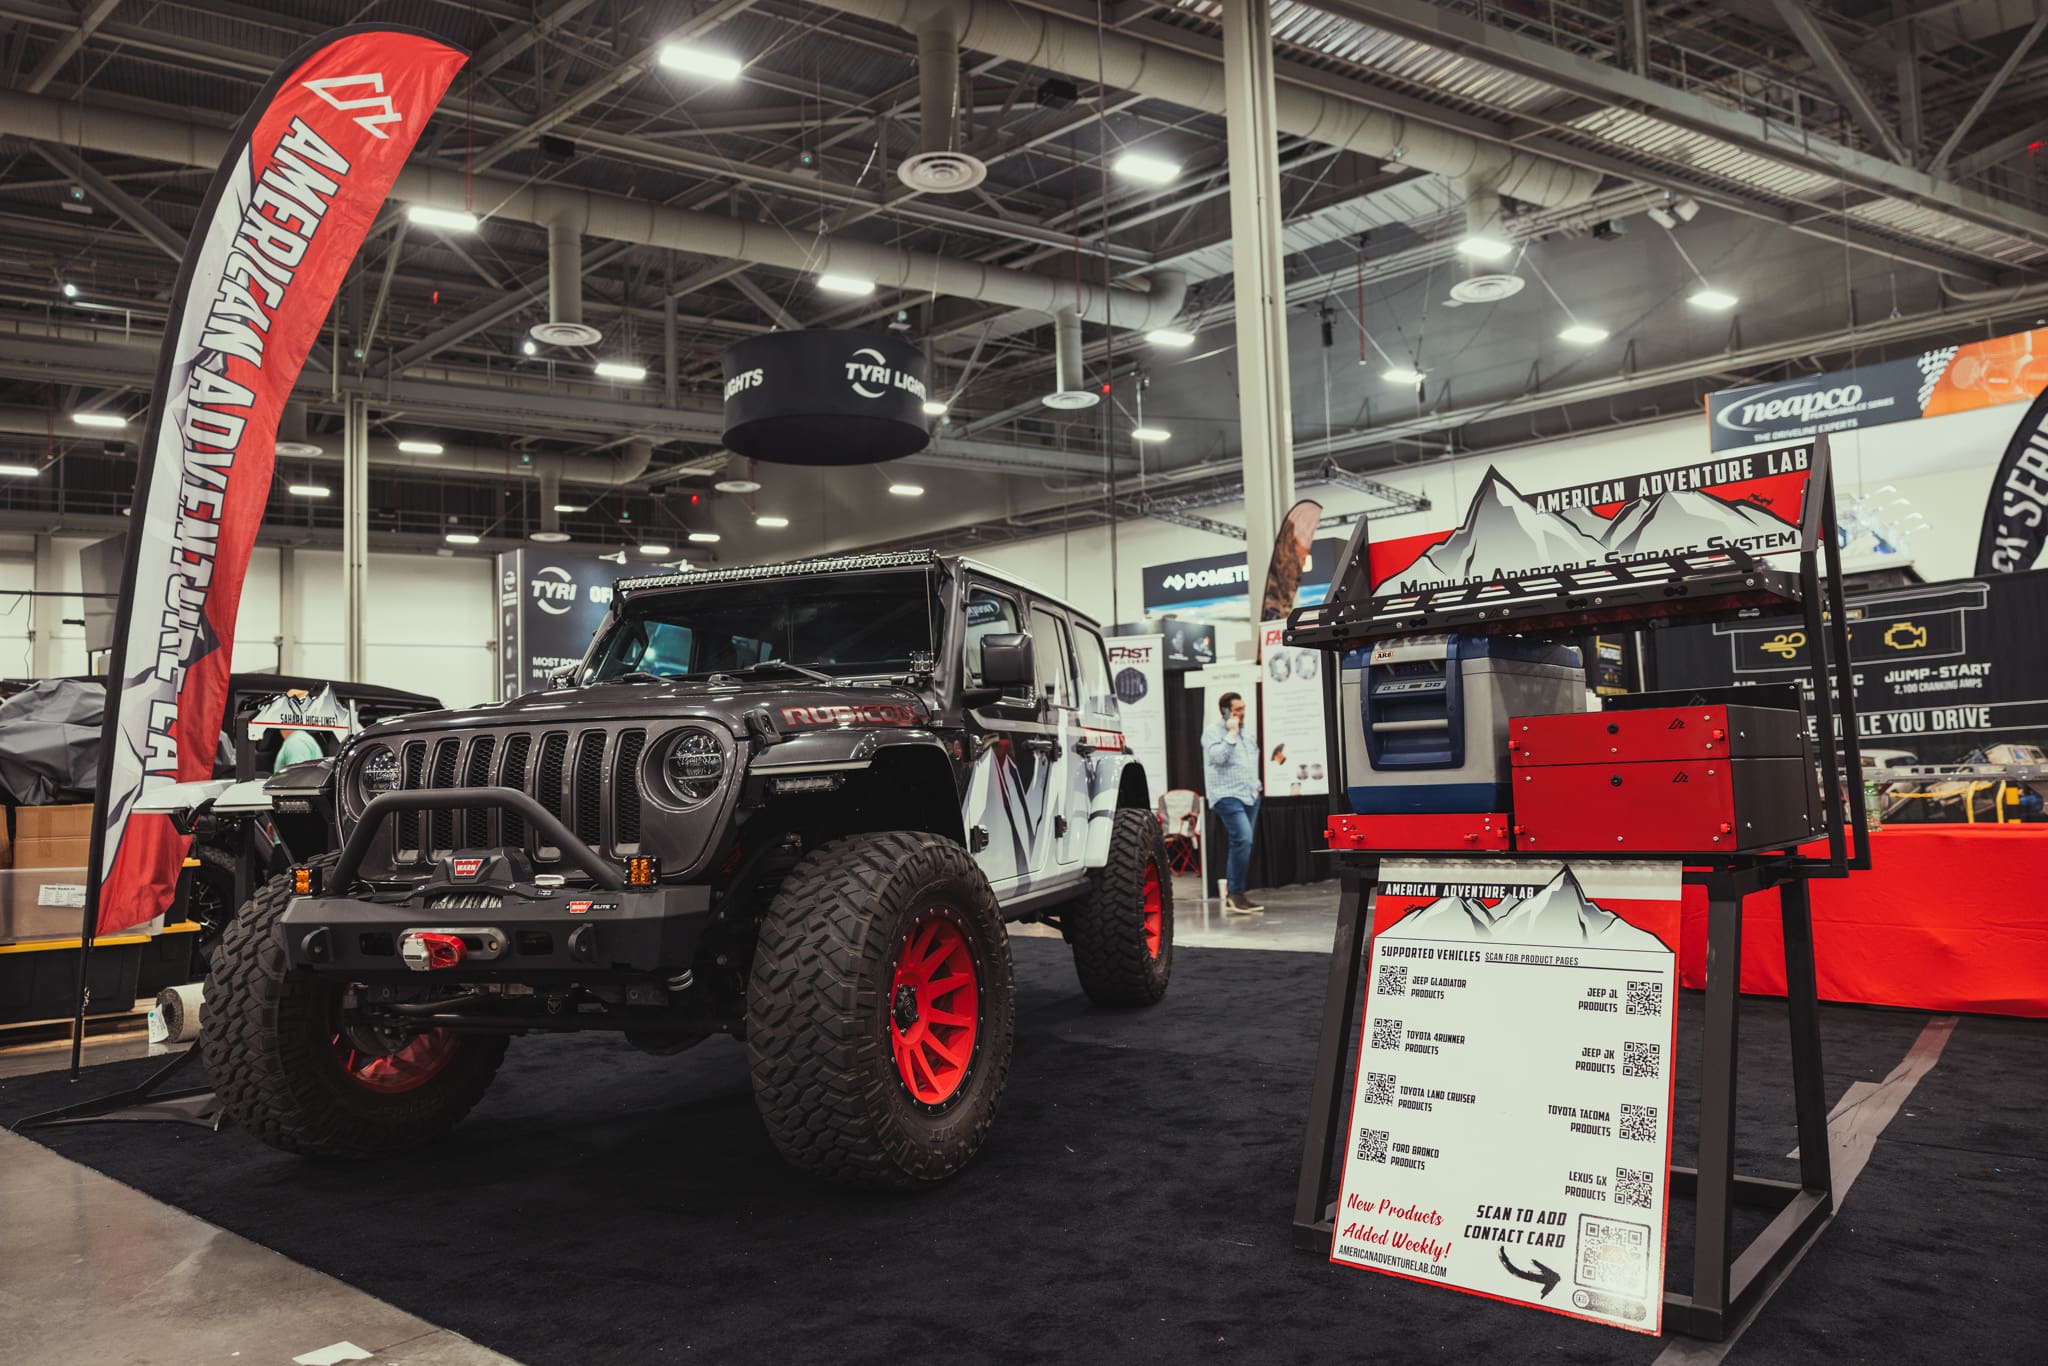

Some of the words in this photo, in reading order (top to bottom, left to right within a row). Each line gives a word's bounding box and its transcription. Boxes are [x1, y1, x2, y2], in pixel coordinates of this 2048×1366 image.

[200, 116, 351, 369] AMERICAN
[846, 362, 891, 384] TYRI
[1742, 385, 1862, 425] neapco
[1754, 433, 1771, 442] THE
[1818, 420, 1858, 433] EXPERTS
[1536, 482, 1624, 515] AMERICAN
[1638, 459, 1752, 498] ADVENTURE
[1768, 449, 1808, 475] LAB
[532, 580, 577, 600] TYRI
[532, 656, 559, 666] MOST
[1108, 647, 1152, 662] FAST
[532, 669, 544, 678] IN
[1884, 663, 1991, 683] JUMP-START
[1960, 678, 1982, 688] AMPS
[280, 714, 303, 725] SAHARA
[1887, 712, 1925, 733] YOU
[1932, 708, 1991, 730] DRIVE
[1386, 884, 1436, 896] AMERICAN
[1443, 885, 1505, 898] ADVENTURE
[1512, 887, 1534, 899] LAB
[1381, 946, 1434, 959] SUPPORTED
[1437, 949, 1480, 962] VEHICLES
[1485, 952, 1503, 962] SCAN
[1505, 953, 1519, 962] FOR
[1521, 954, 1553, 964] PRODUCT
[1555, 956, 1579, 966] PAGES
[1412, 976, 1428, 985] JEEP
[1431, 977, 1467, 988] GLADIATOR
[1411, 988, 1444, 1000] PRODUCTS
[1587, 988, 1606, 998] JEEP
[1609, 990, 1618, 998] JL
[1578, 1001, 1618, 1012] PRODUCTS
[1406, 1030, 1431, 1041] TOYOTA
[1434, 1033, 1465, 1044] 4RUNNER
[1405, 1043, 1439, 1055] PRODUCTS
[1582, 1047, 1601, 1057] JEEP
[1604, 1050, 1614, 1059] JK
[1576, 1061, 1615, 1074] PRODUCTS
[1400, 1086, 1425, 1097] TOYOTA
[1427, 1089, 1445, 1100] LAND
[1447, 1092, 1476, 1104] CRUISER
[1398, 1099, 1432, 1112] PRODUCTS
[1548, 1104, 1576, 1117] TOYOTA
[1580, 1109, 1610, 1121] TACOMA
[1571, 1122, 1611, 1136] PRODUCTS
[1392, 1142, 1410, 1154] FORD
[1412, 1146, 1439, 1158] BRONCO
[1390, 1156, 1425, 1170] PRODUCTS
[1569, 1170, 1593, 1184] LEXUS
[1596, 1175, 1607, 1186] GX
[1565, 1185, 1606, 1201] PRODUCTS
[1347, 1192, 1375, 1212] New
[1378, 1199, 1445, 1226] Products
[1476, 1205, 1512, 1220] SCAN
[1516, 1208, 1532, 1222] TO
[1536, 1210, 1567, 1226] ADD
[1342, 1222, 1389, 1245] Added
[1392, 1232, 1452, 1262] Weekly!
[1464, 1224, 1524, 1244] CONTACT
[1527, 1231, 1566, 1248] CARD
[1338, 1244, 1447, 1278] AMERICANADVENTURELAB.COM
